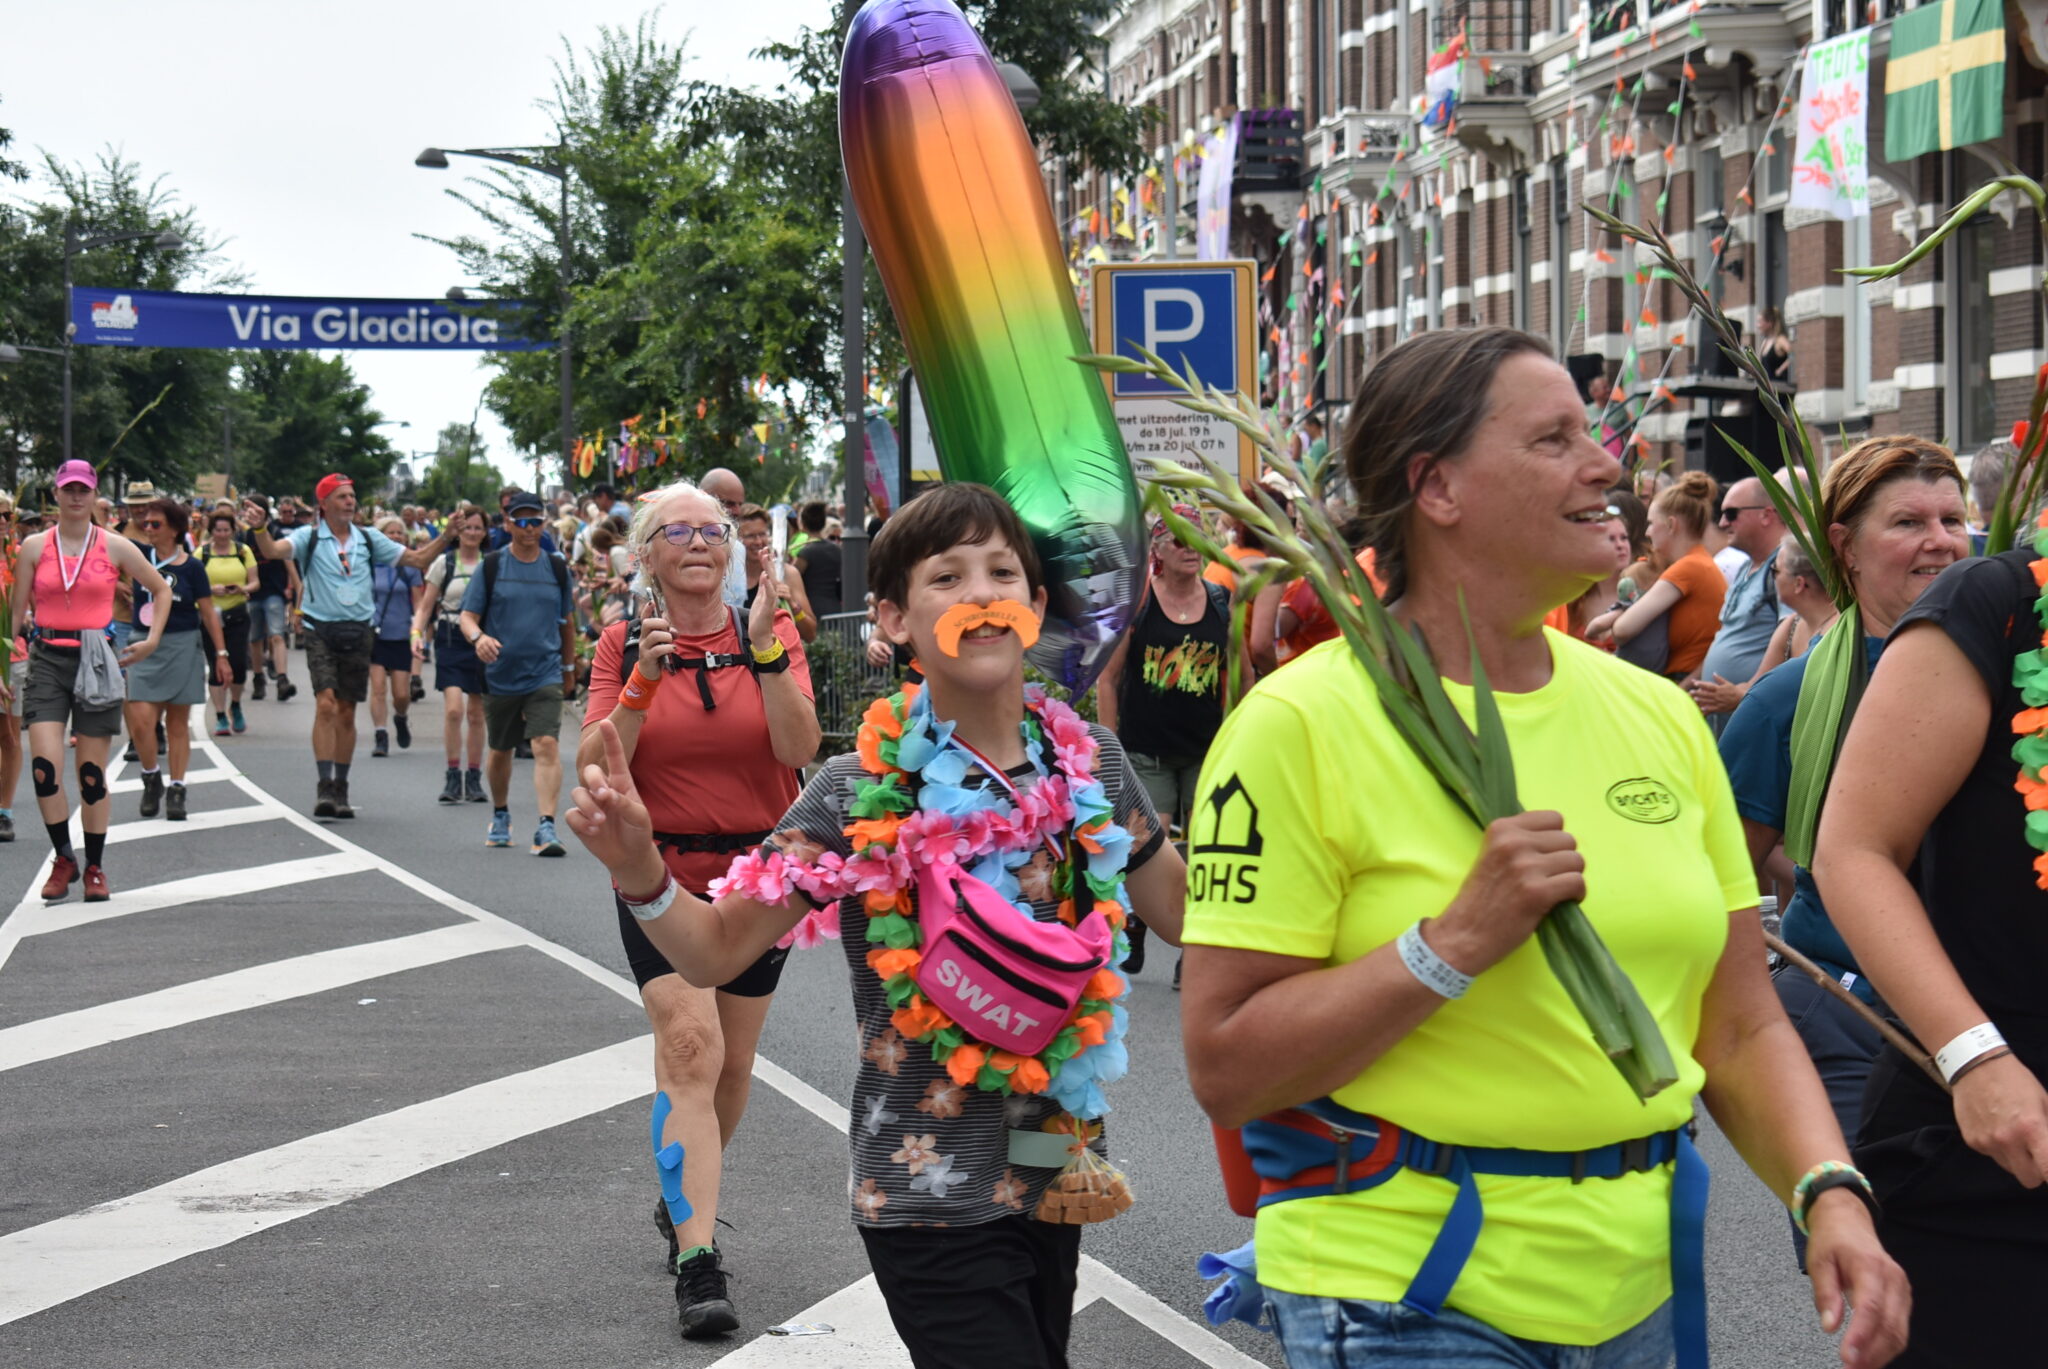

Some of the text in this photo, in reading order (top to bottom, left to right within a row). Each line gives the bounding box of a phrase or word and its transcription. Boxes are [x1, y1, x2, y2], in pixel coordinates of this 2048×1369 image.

[1812, 33, 1868, 86] TROTS
[228, 304, 498, 344] Via Gladiola
[1143, 287, 1204, 379] P
[1117, 414, 1137, 424] met
[1140, 412, 1209, 425] uitzondering
[1140, 427, 1210, 439] do 18 jul. 19 h
[1127, 440, 1225, 452] t/m za 20 jul. 07 h
[1186, 862, 1260, 904] OHS
[936, 959, 1040, 1036] SWAT
